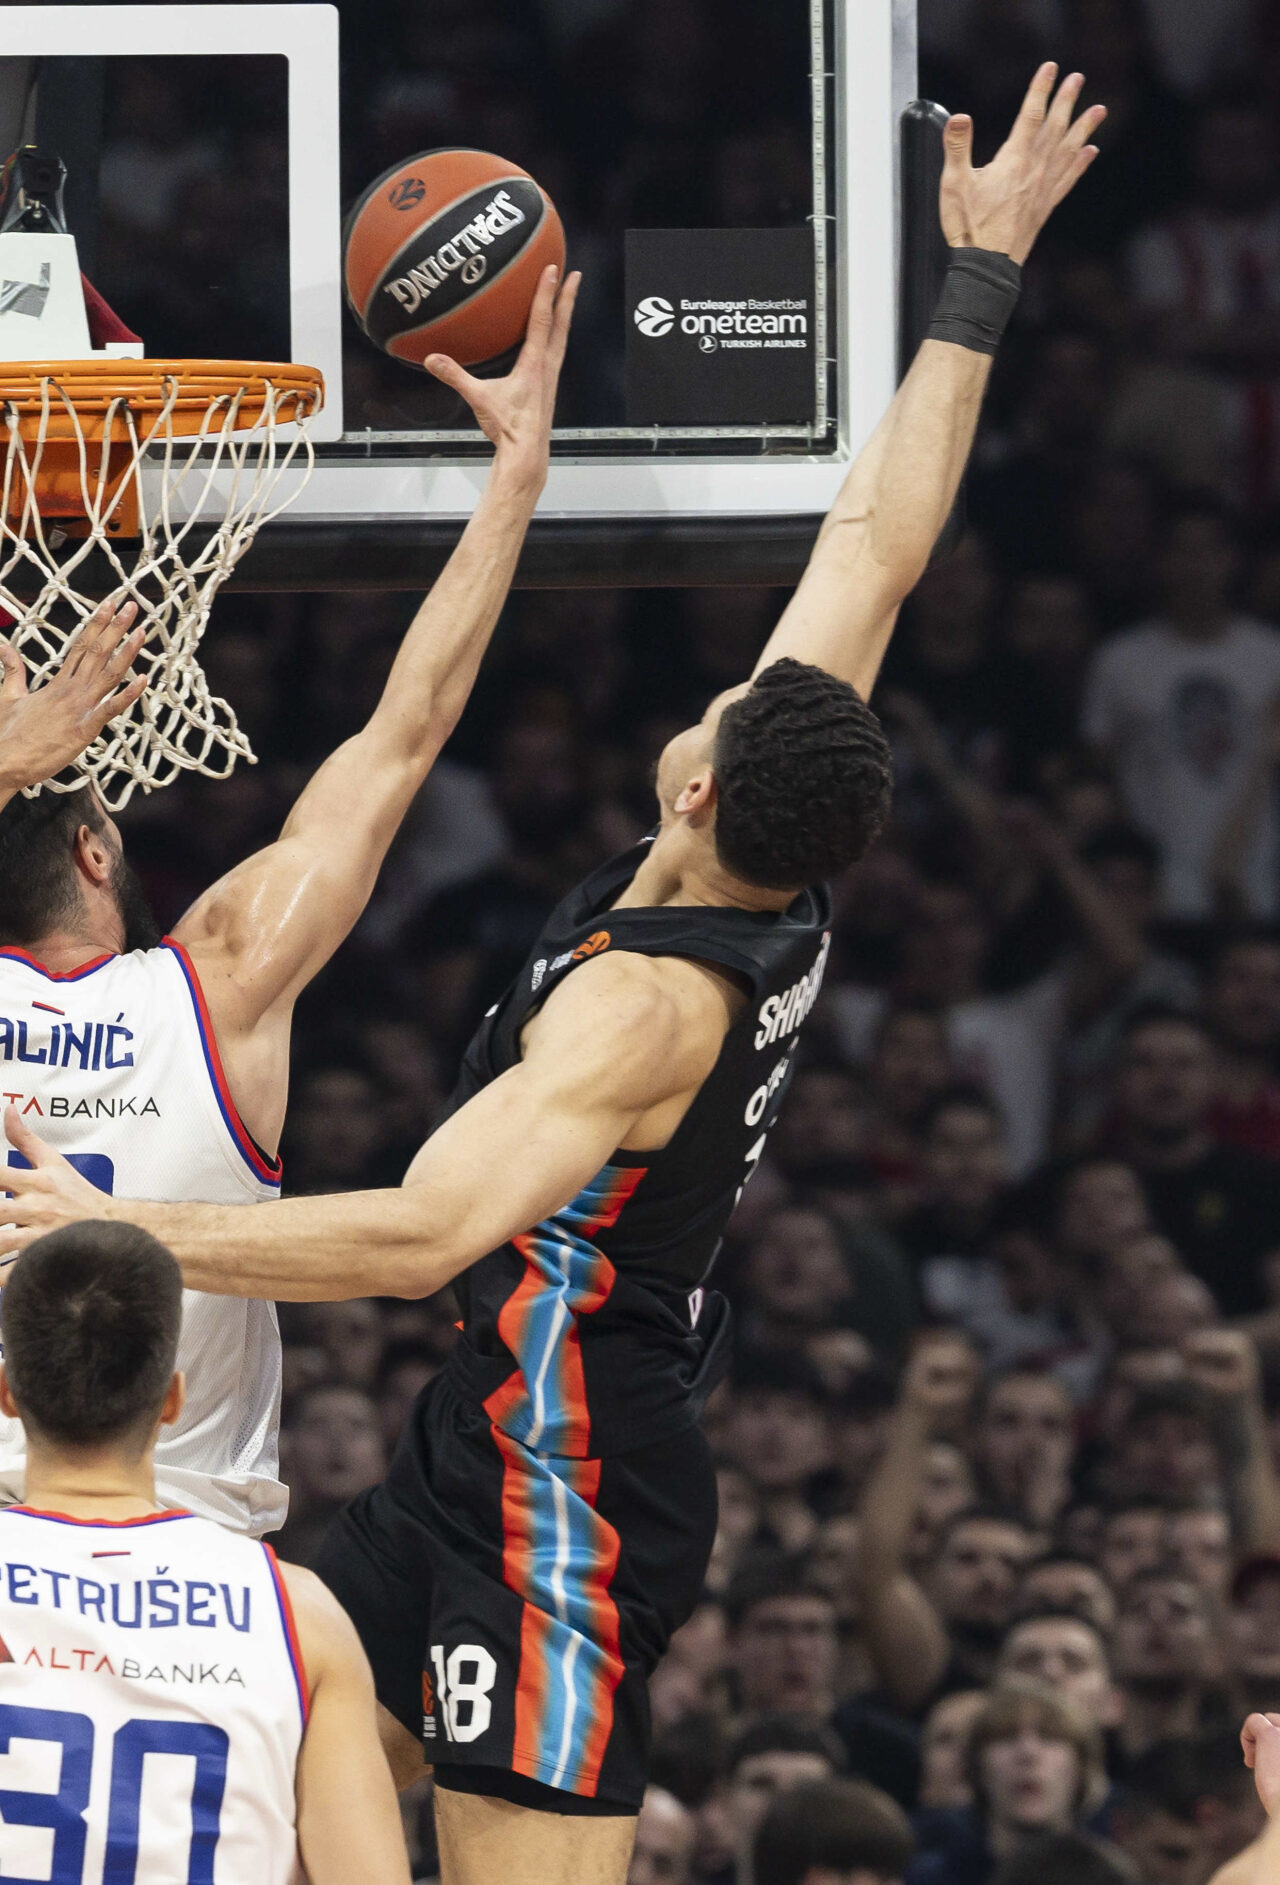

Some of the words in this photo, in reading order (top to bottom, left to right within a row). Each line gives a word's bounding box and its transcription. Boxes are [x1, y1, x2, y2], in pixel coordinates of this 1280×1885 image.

[383, 190, 526, 314] SPALDING
[680, 299, 747, 313] Euroleague
[748, 299, 807, 310] Basketball
[680, 311, 807, 334] oneteam
[720, 340, 762, 348] TURKISH
[763, 339, 807, 348] AIRLINES
[430, 1644, 497, 1742] 18
